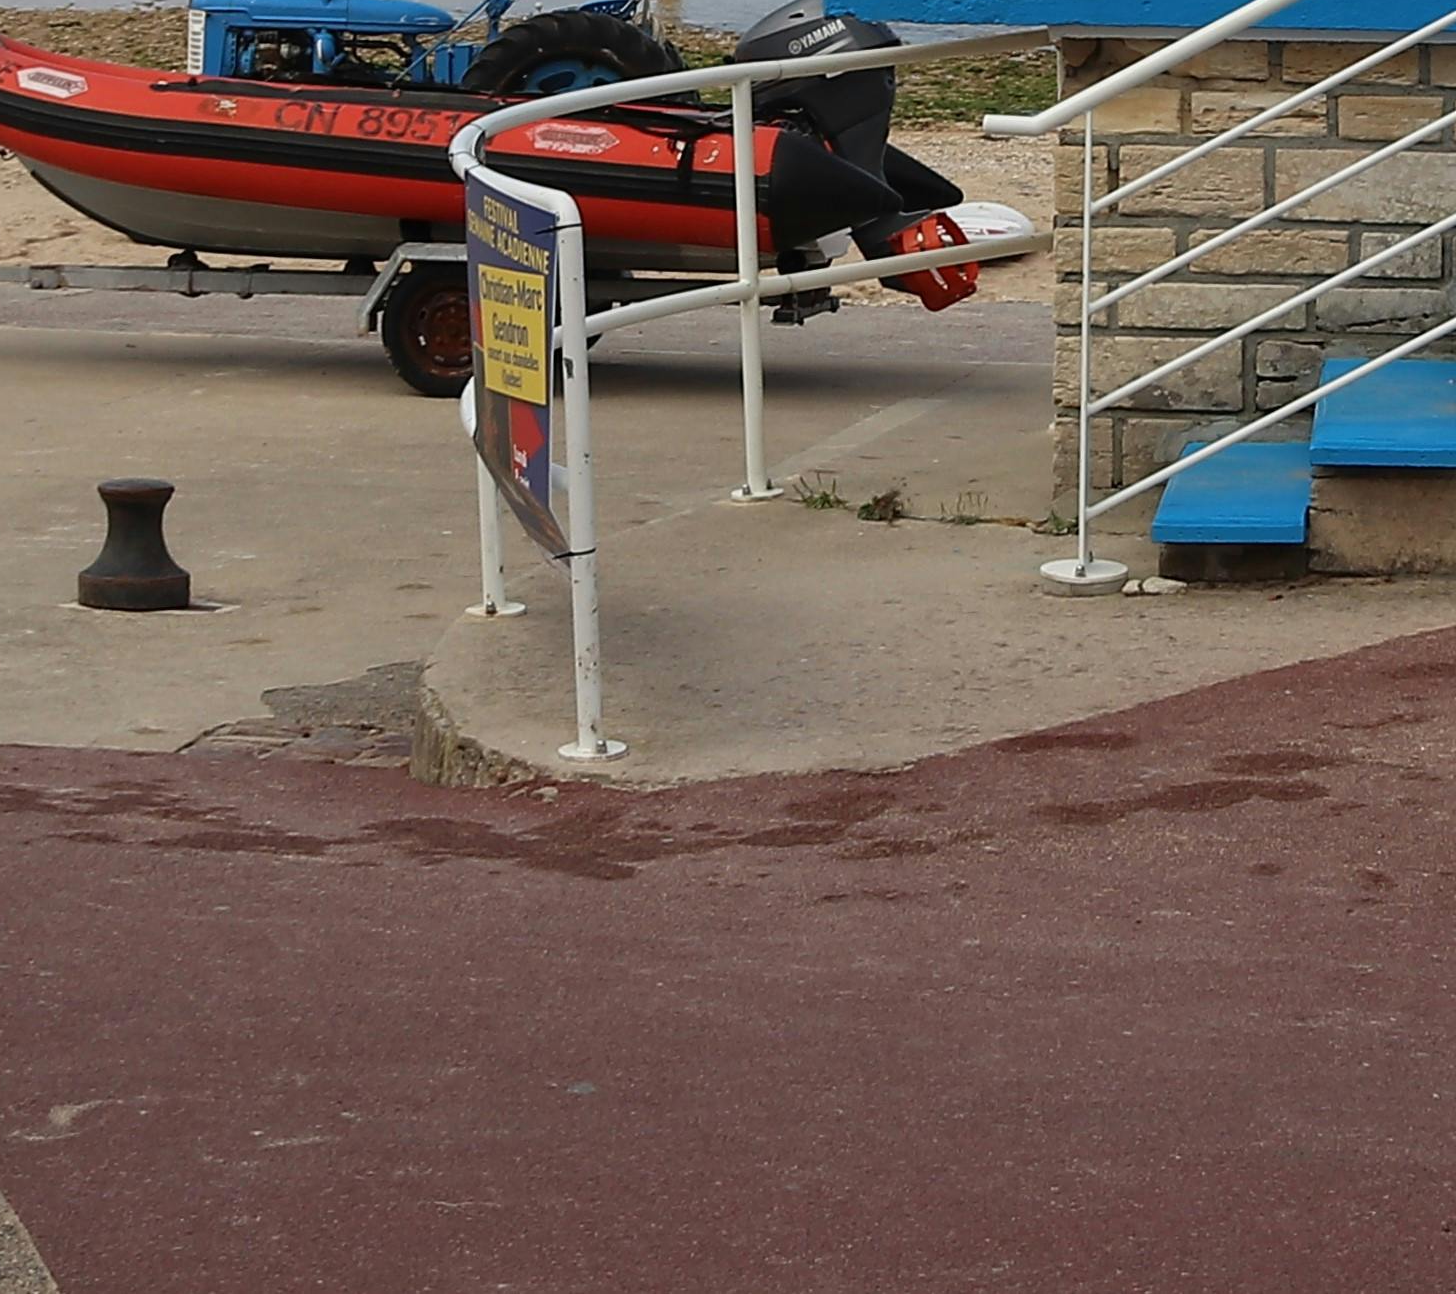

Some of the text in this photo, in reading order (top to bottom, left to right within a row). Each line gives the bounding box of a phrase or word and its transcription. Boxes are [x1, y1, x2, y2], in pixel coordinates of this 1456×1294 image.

[800, 18, 846, 48] YAMAHA
[274, 99, 343, 134] CN
[483, 195, 520, 234] FESTIVAL
[496, 229, 550, 275] ACADIENNE
[481, 271, 543, 312] Christian-Marc
[492, 312, 529, 349] Gendron
